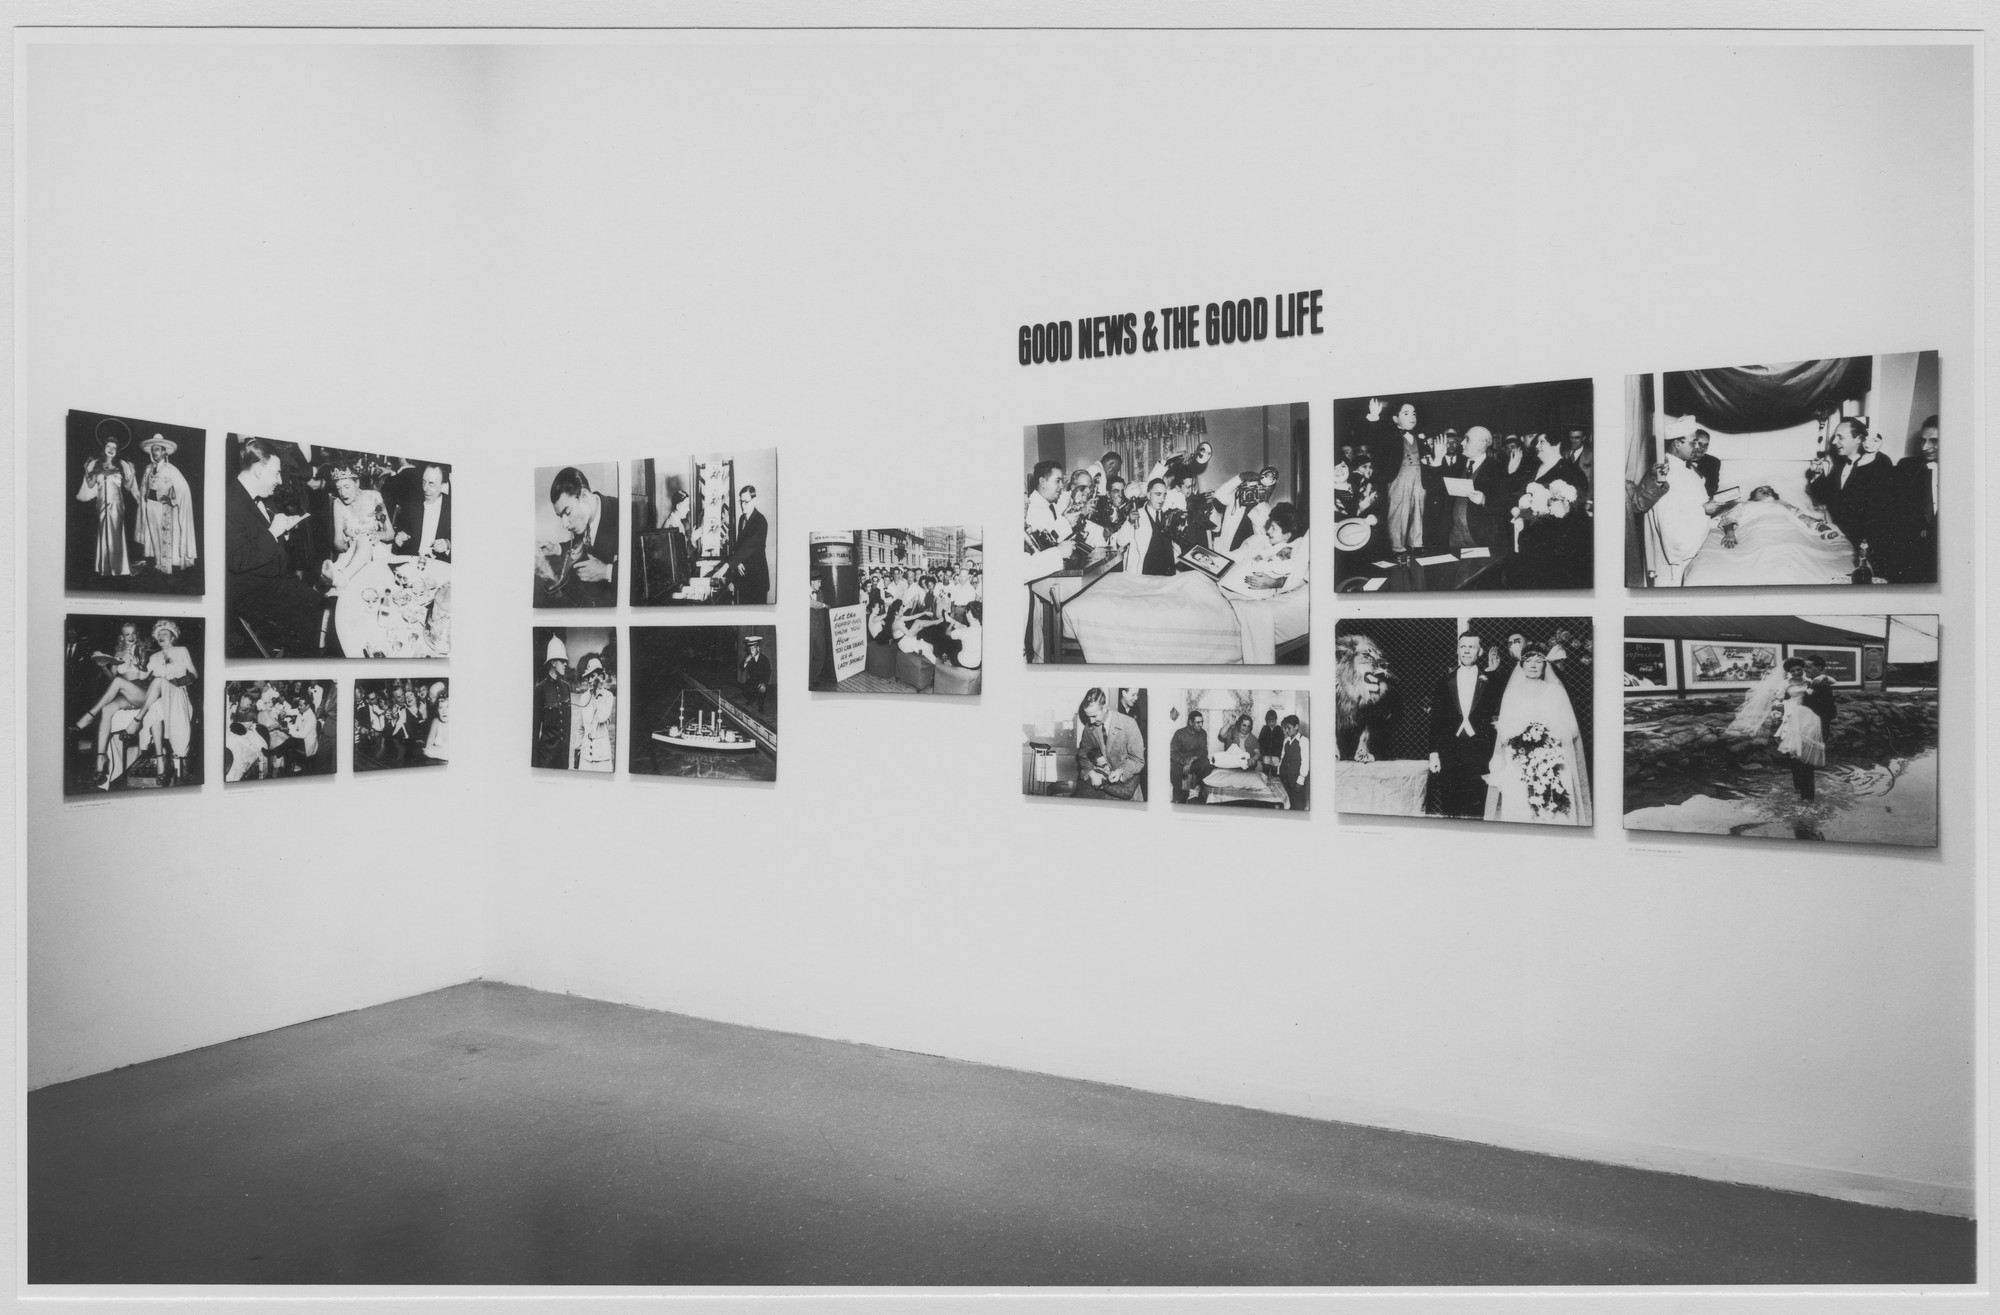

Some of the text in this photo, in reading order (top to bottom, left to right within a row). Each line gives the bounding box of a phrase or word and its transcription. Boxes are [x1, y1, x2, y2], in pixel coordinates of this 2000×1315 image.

[1018, 289, 1324, 365] GOOD NEWS & THE GOOD LIFE
